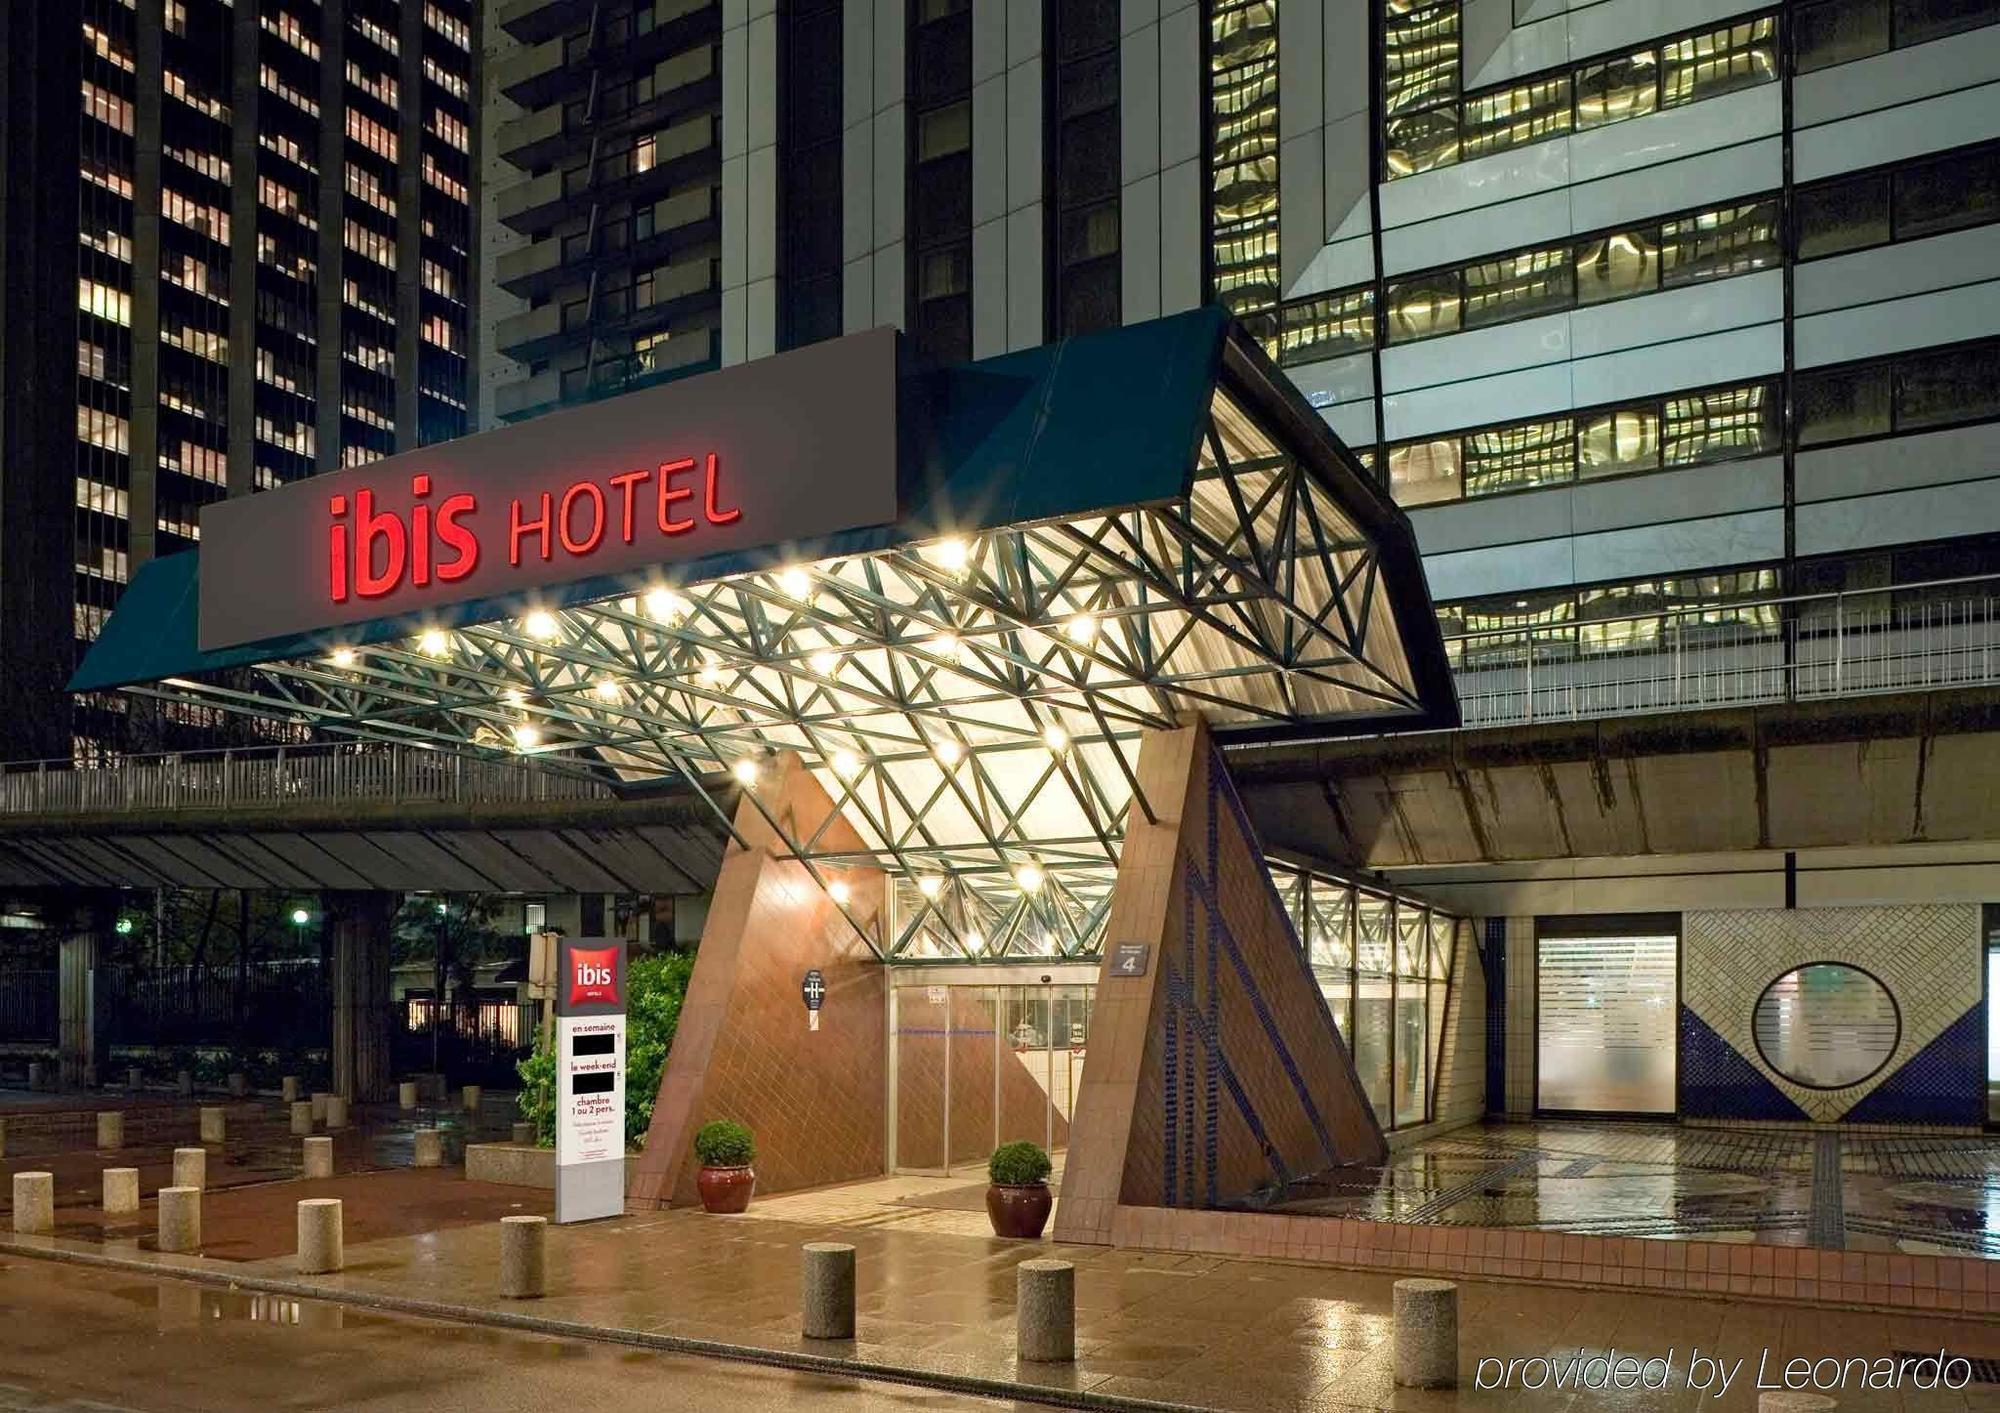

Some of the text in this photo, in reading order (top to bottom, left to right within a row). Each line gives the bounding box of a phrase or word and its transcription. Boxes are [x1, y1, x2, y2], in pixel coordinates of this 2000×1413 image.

[330, 453, 741, 601] ibis HOTEL
[1122, 956, 1136, 972] 4
[578, 962, 611, 986] ibis
[584, 1023, 615, 1032] semaine
[571, 1058, 616, 1071] le week-end
[577, 1094, 610, 1106] chambre
[589, 1106, 594, 1114] 2
